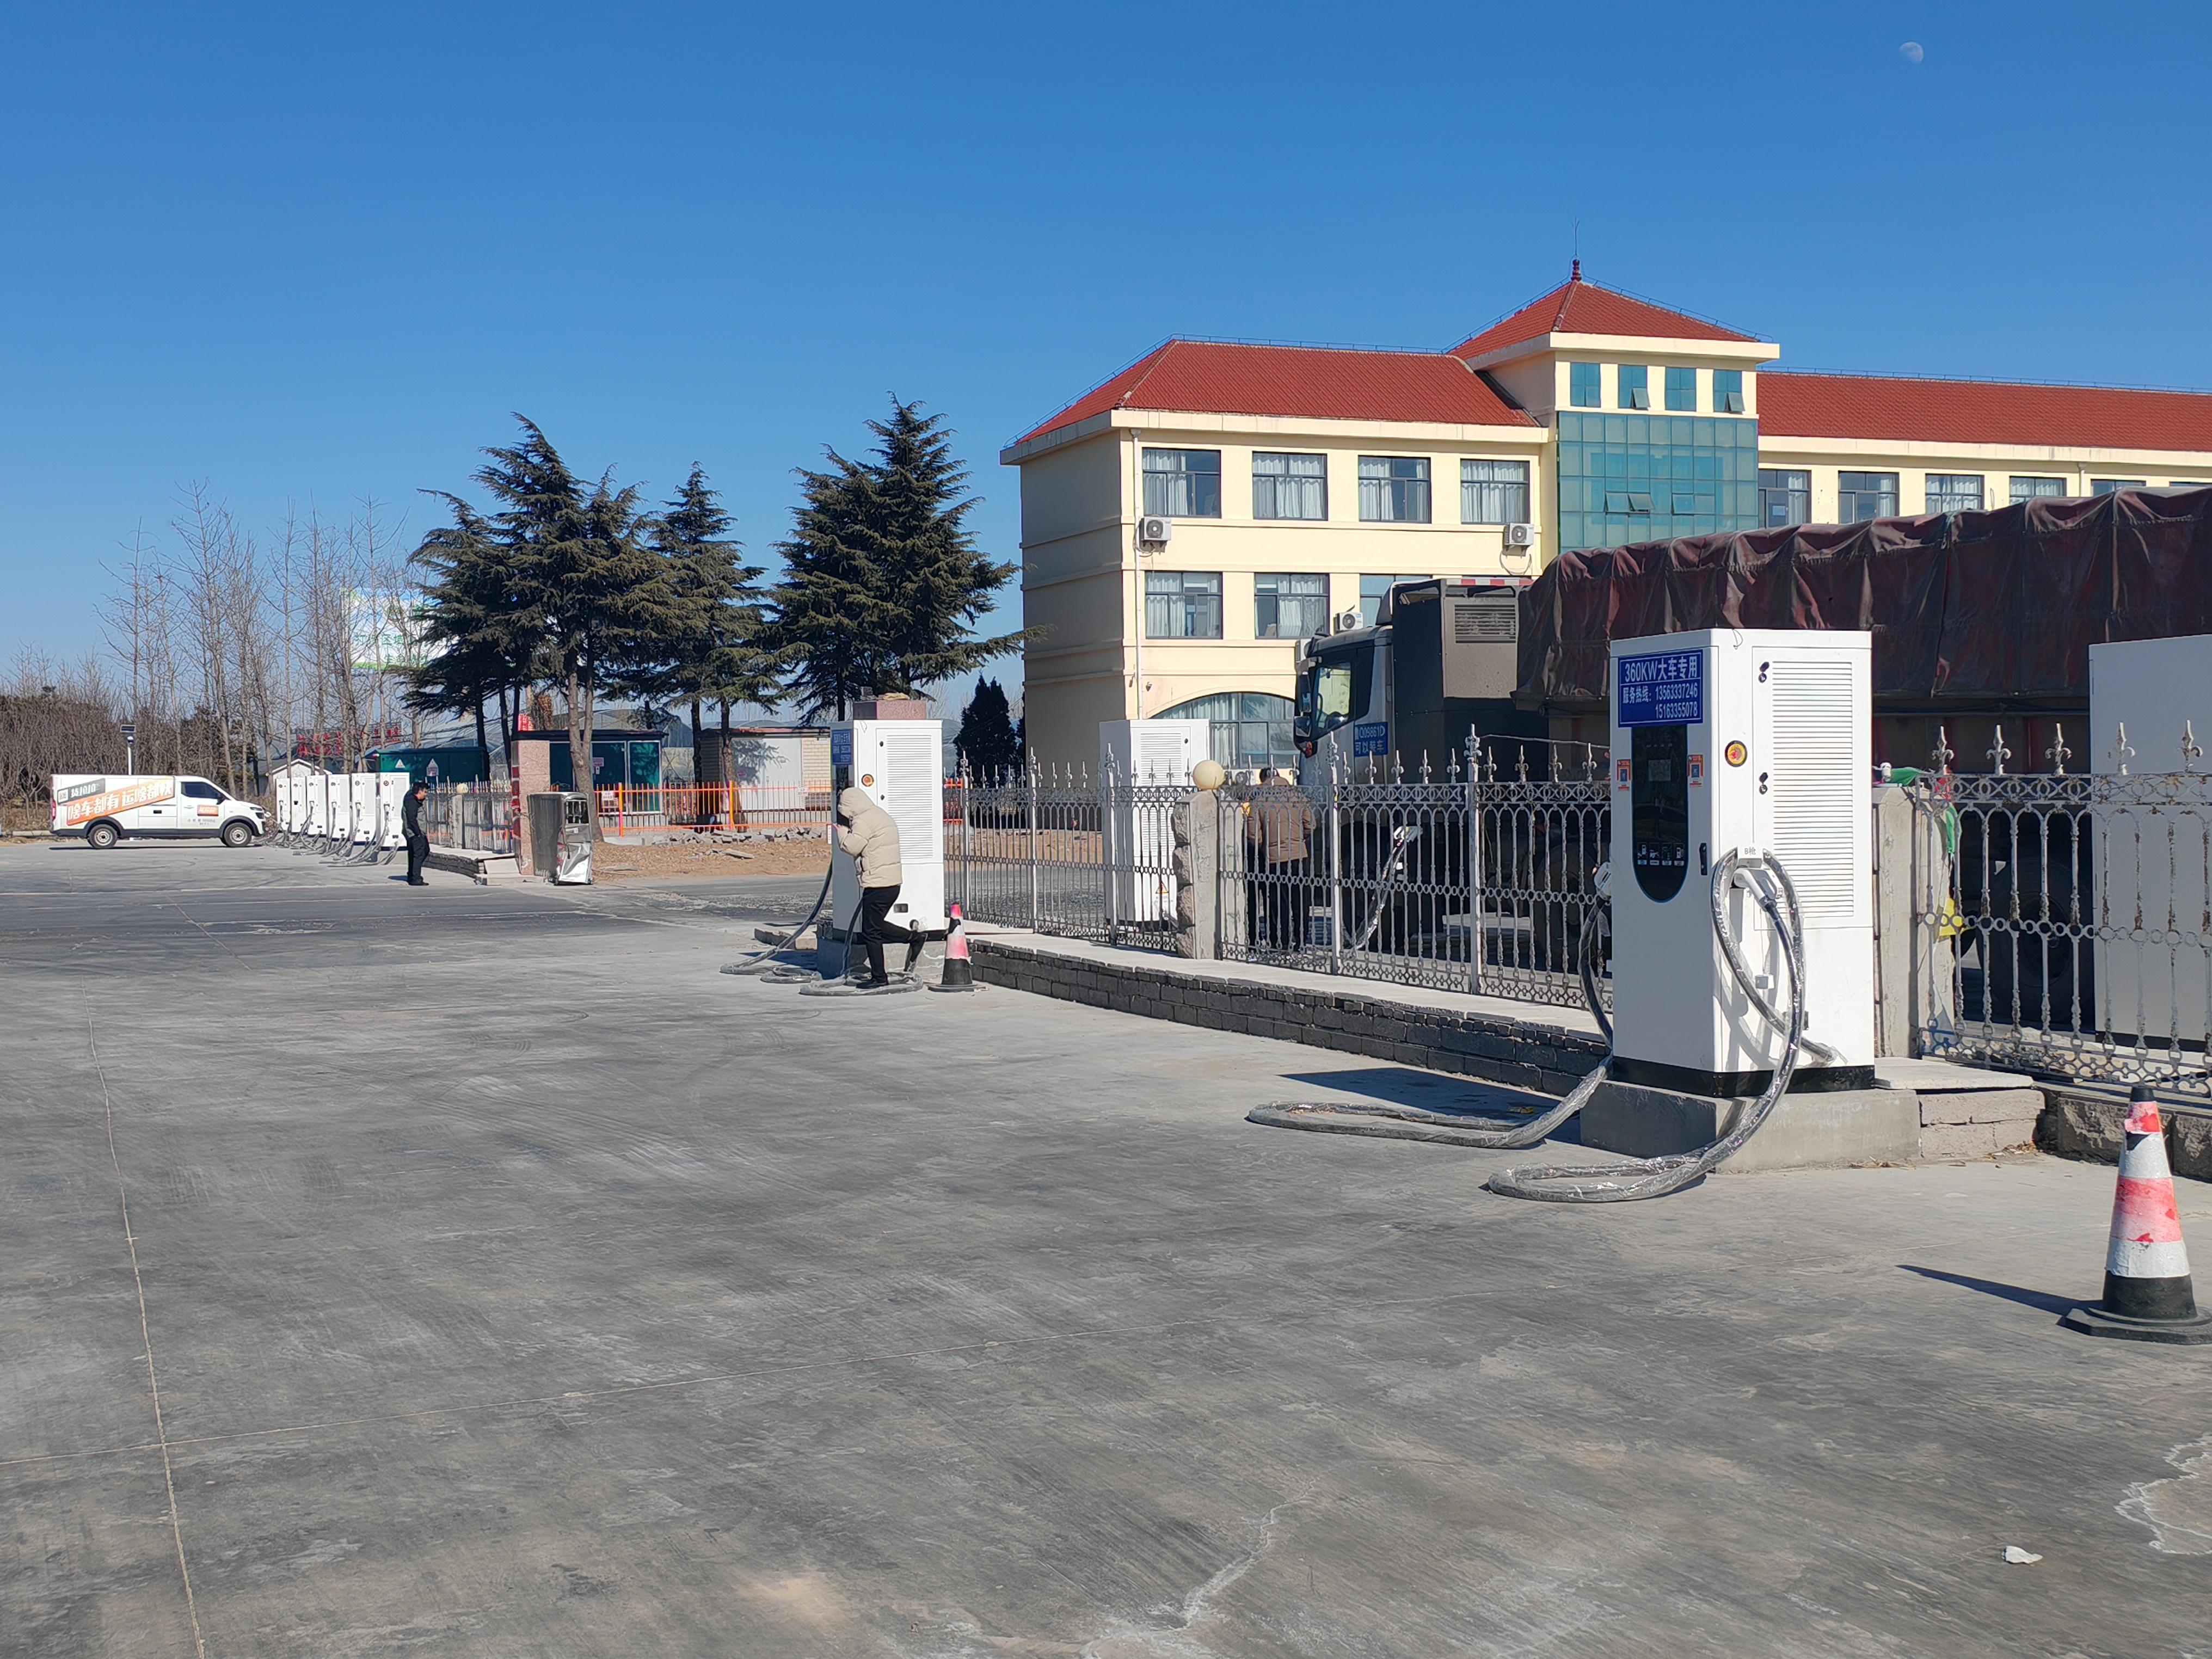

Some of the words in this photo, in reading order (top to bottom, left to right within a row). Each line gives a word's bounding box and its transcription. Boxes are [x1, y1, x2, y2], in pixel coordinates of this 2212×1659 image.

[1625, 656, 1697, 682] 360KW大车专用
[1655, 682, 1698, 701] 13563337246
[1655, 701, 1698, 718] 15163355078
[67, 794, 119, 821] 啥车都有
